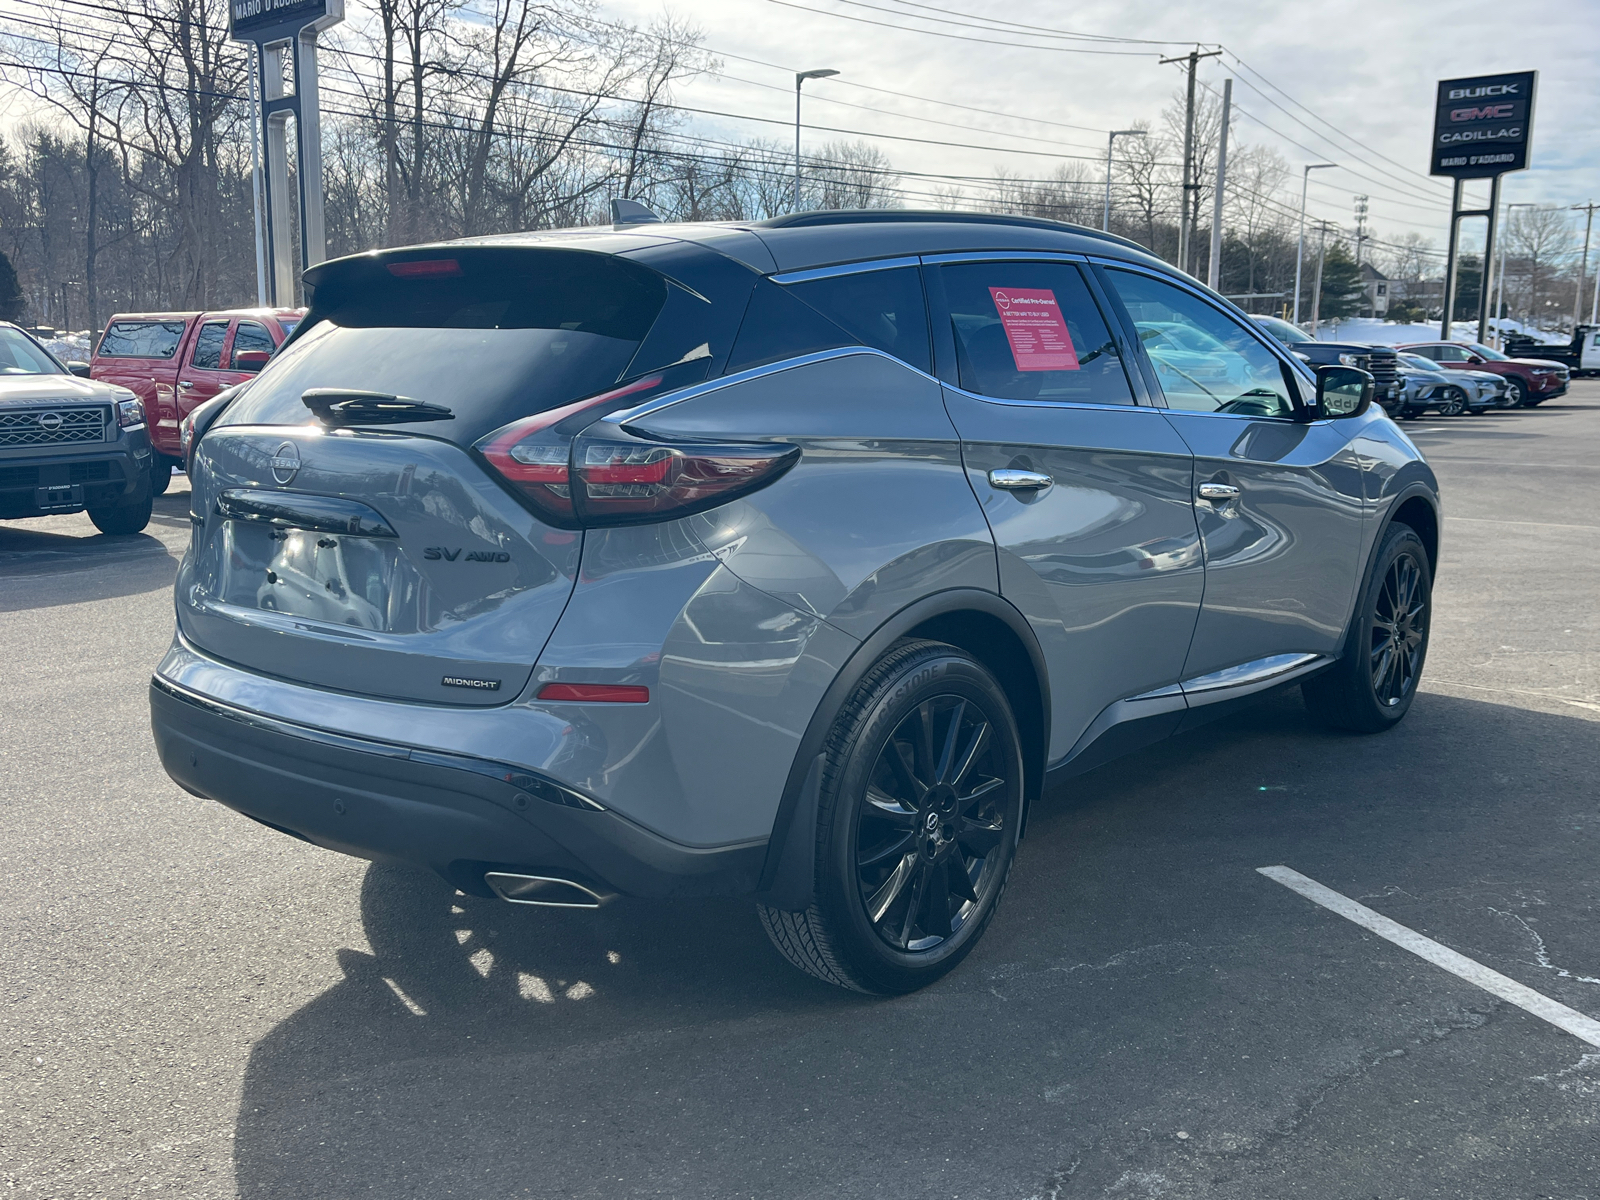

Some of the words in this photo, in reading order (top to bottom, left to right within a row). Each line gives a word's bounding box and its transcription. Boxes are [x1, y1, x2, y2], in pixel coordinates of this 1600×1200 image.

[235, 0, 261, 20] MARIO
[1449, 83, 1519, 99] BUICK
[1450, 104, 1514, 122] GMC
[1440, 127, 1521, 142] CADILLAC
[1441, 157, 1467, 167] MARIO
[1469, 153, 1516, 165] D'ADDARIO
[0, 396, 94, 405] RONTIER
[423, 546, 462, 562] SV
[464, 550, 510, 563] AWD
[443, 677, 497, 689] MIDNIGHT
